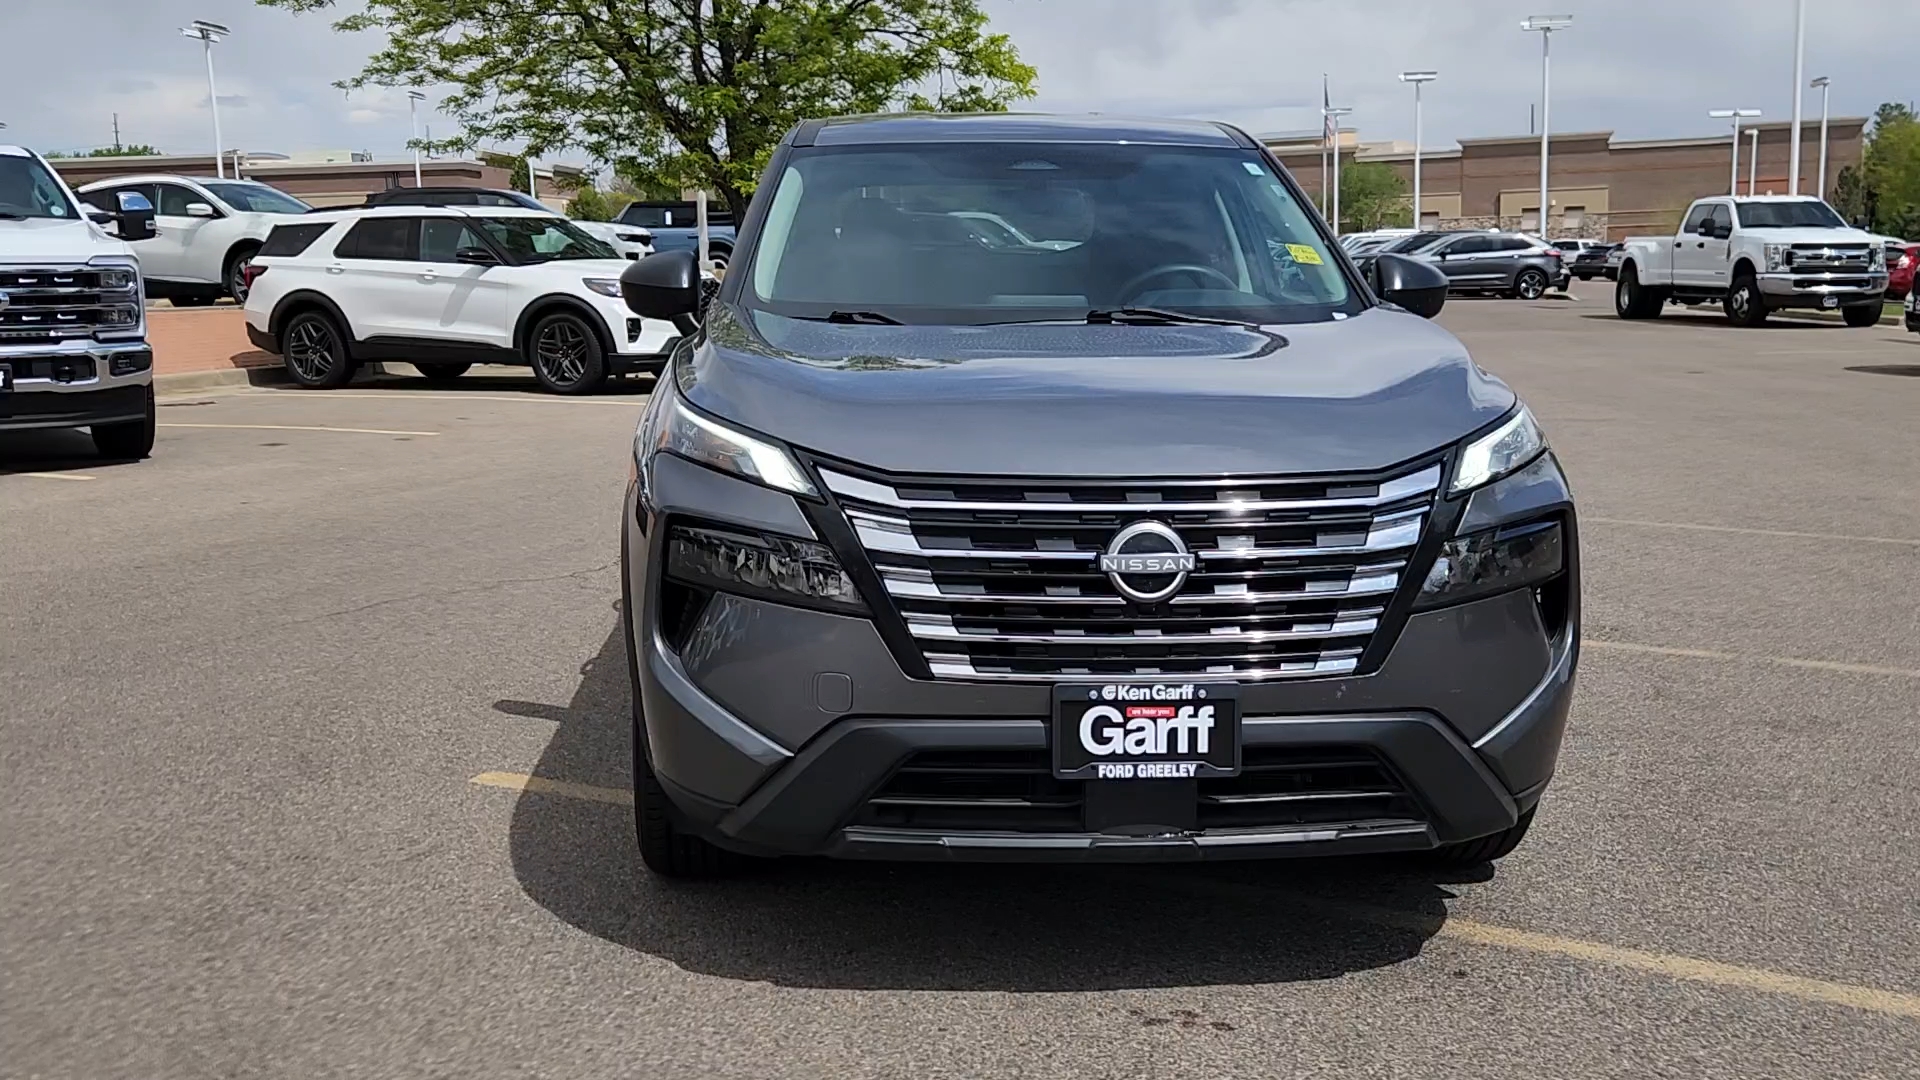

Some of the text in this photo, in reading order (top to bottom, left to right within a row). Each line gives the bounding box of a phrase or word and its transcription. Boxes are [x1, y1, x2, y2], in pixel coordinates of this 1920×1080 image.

[1102, 558, 1193, 571] NISSAN
[1117, 685, 1151, 700] Ken
[1151, 684, 1194, 700] Garff
[1079, 705, 1215, 756] Garff
[1098, 763, 1197, 778] FORD GREELEY
